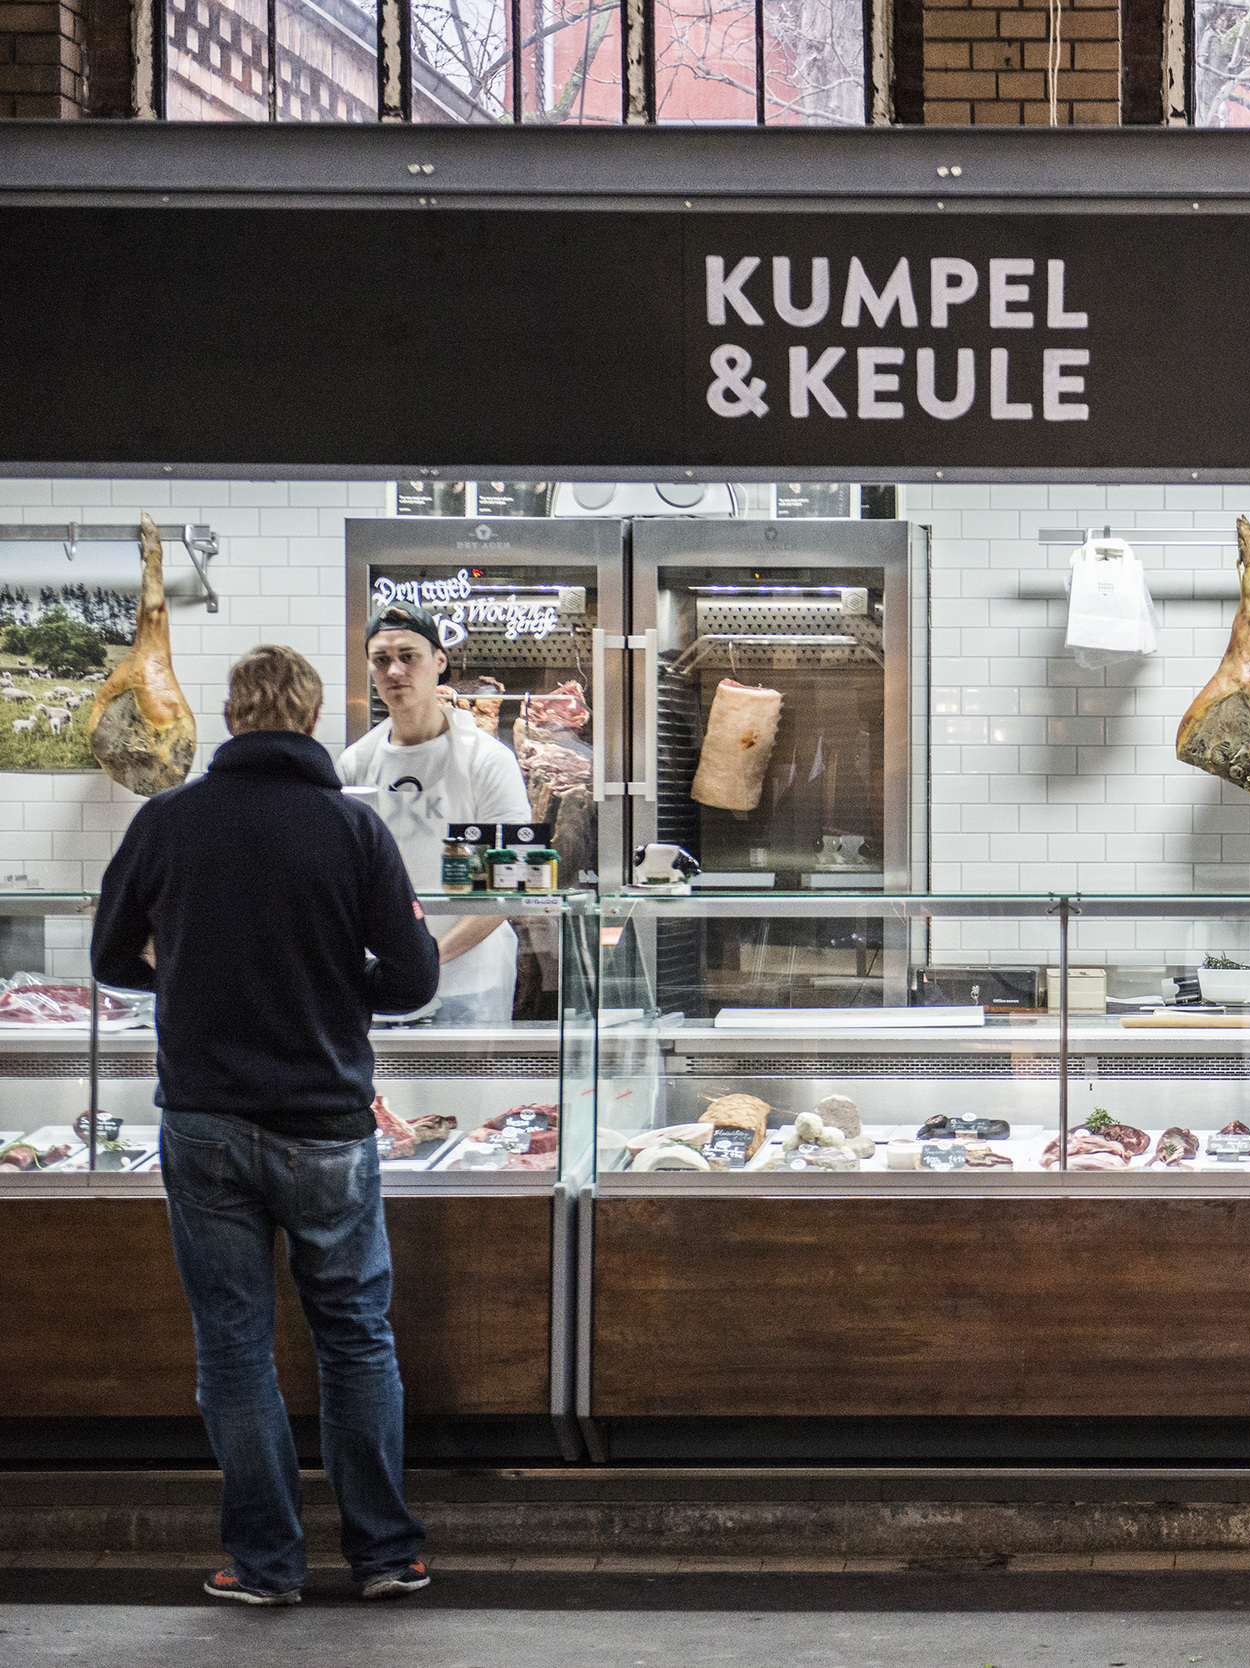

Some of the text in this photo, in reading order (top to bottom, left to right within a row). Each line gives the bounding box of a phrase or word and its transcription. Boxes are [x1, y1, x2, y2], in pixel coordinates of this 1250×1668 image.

[705, 255, 1089, 330] KUMPEL
[706, 344, 1090, 421] & KEULE
